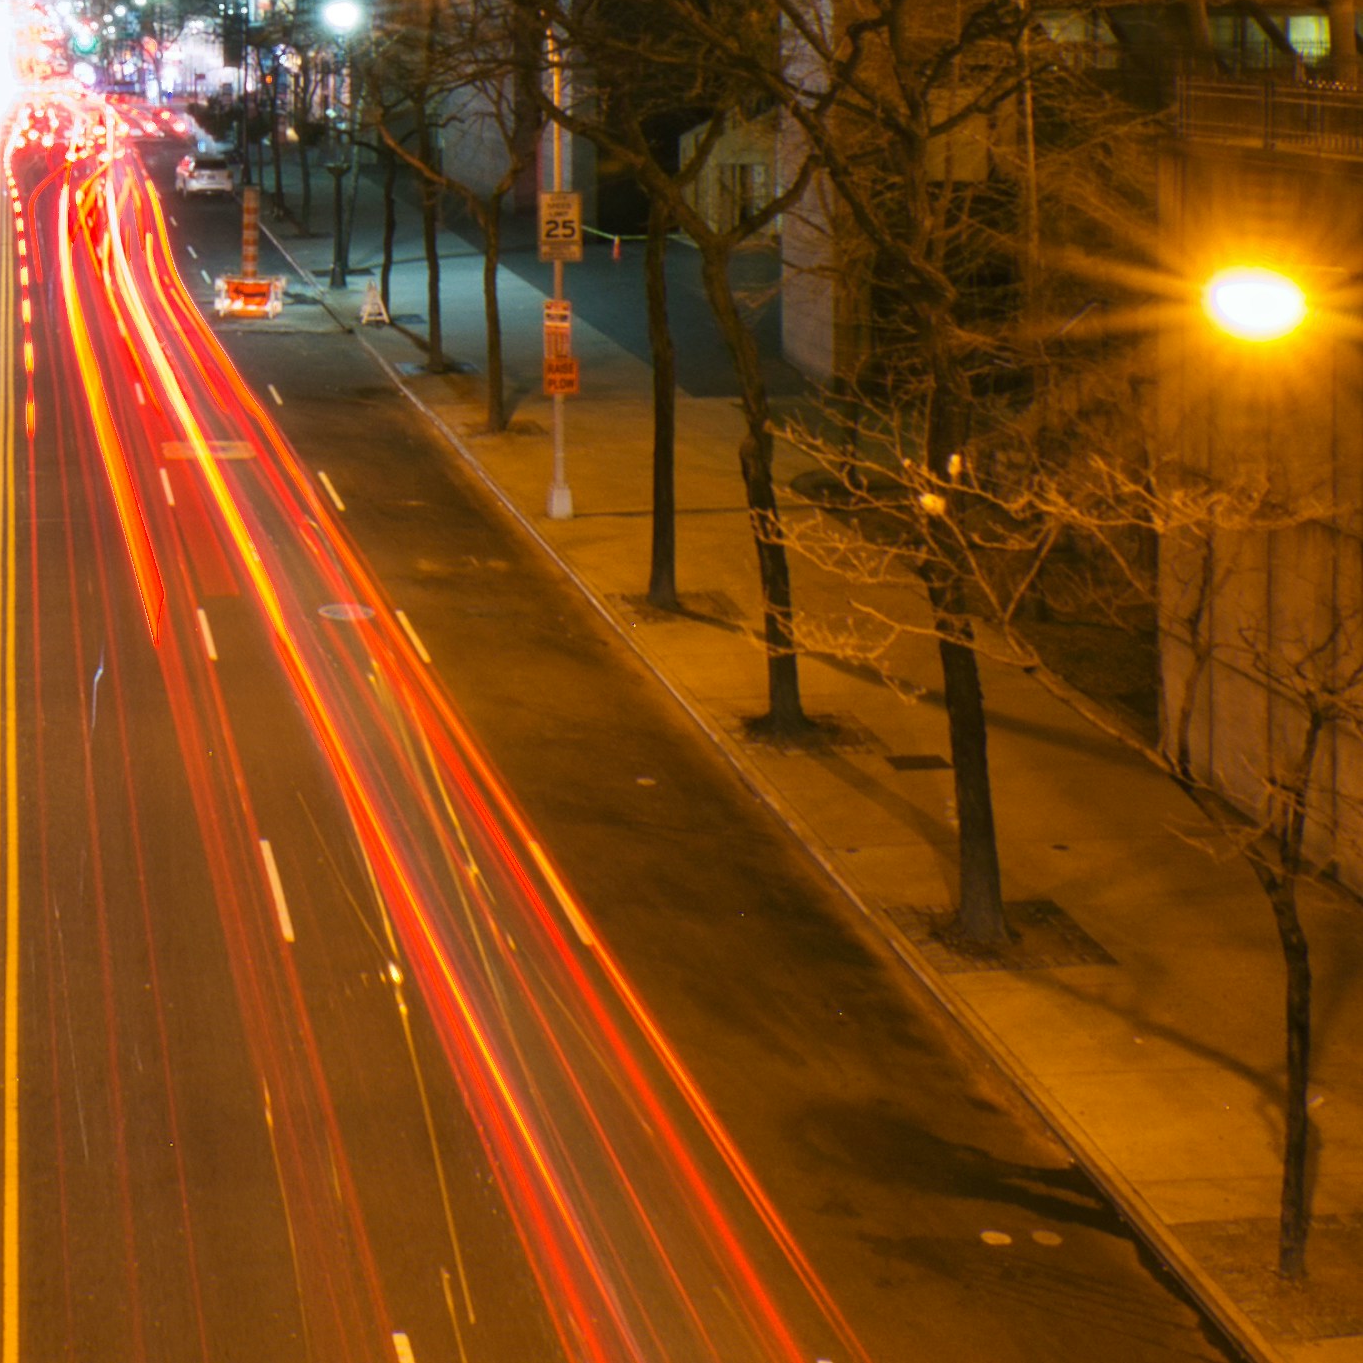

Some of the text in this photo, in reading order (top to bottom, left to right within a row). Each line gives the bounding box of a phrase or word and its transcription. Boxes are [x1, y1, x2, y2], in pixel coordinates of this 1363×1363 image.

[545, 220, 576, 238] 25
[548, 363, 574, 374] RAISE
[548, 378, 574, 389] PLOW
